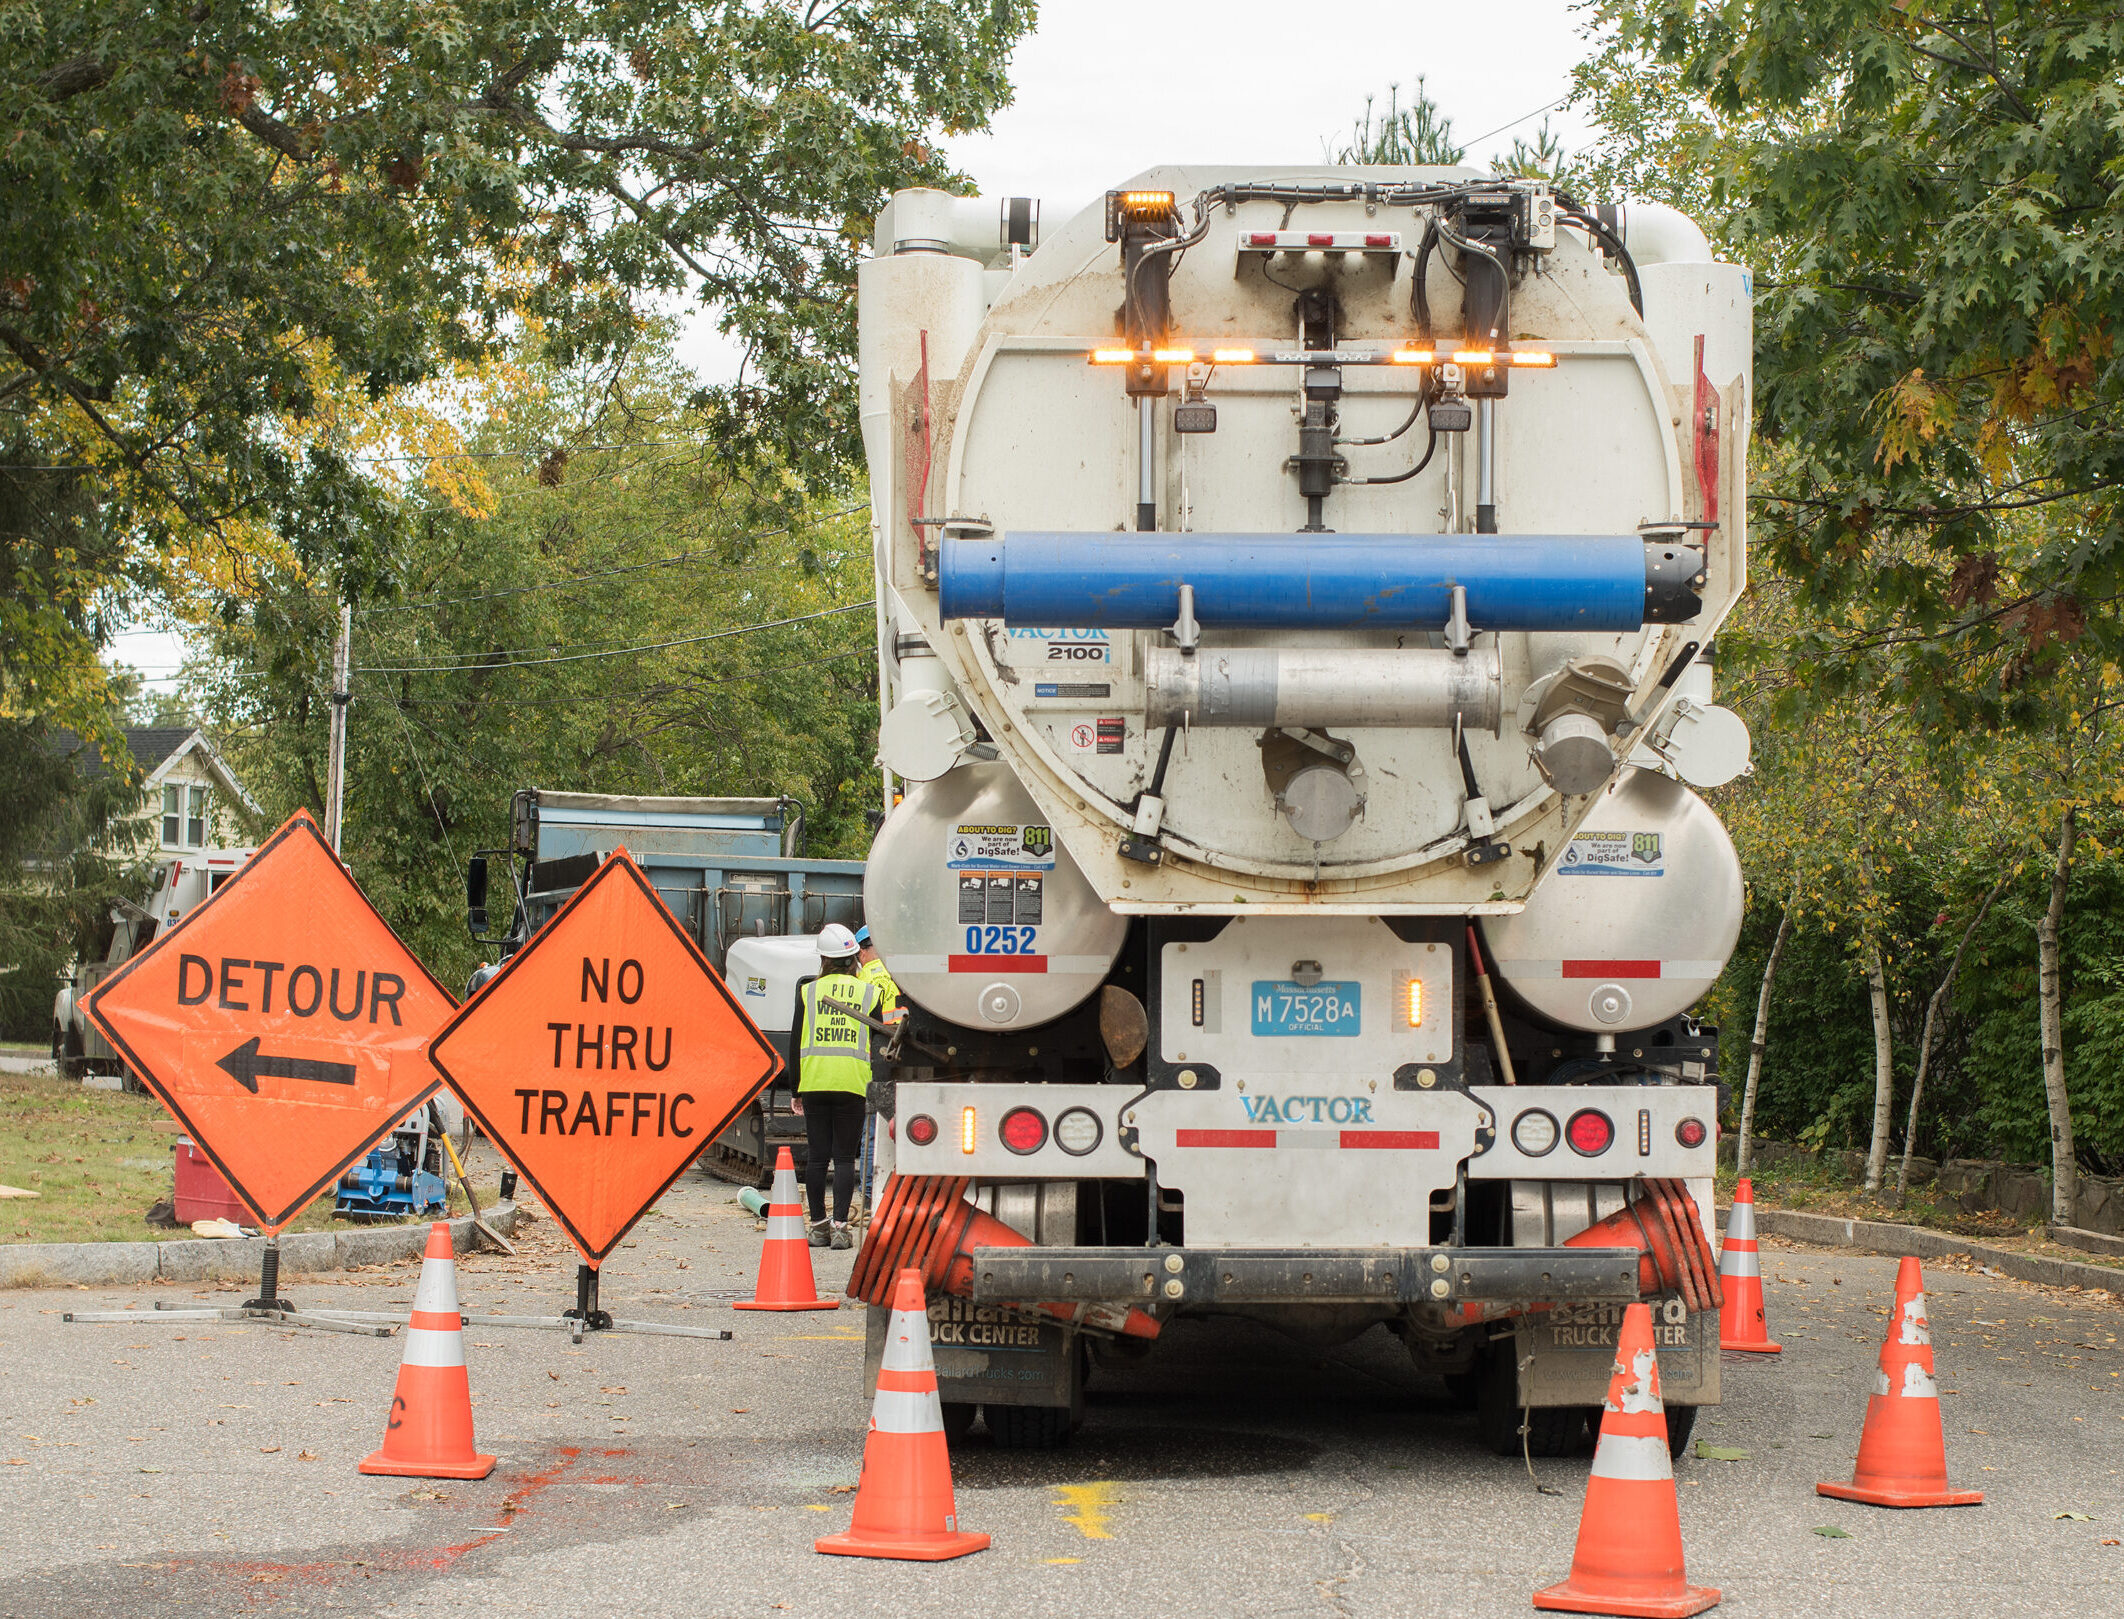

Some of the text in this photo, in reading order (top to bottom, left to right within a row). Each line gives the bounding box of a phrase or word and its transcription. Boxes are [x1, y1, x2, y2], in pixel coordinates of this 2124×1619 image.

[1048, 647, 1111, 664] 2100i
[957, 825, 1018, 835] ABOUT TO DIG?
[1024, 826, 1051, 846] 811
[1573, 832, 1627, 841] BOUT TO DIG?
[977, 847, 1020, 857] DigSafe!
[1633, 834, 1659, 852] 811
[1587, 853, 1629, 863] DigSafe!
[966, 925, 1037, 954] 0252
[178, 954, 406, 1026] DETOUR
[581, 957, 644, 1005] NO
[1257, 995, 1272, 1023] M
[830, 1017, 846, 1026] AND
[1288, 1023, 1324, 1031] OFFICIAL
[816, 1027, 857, 1043] SEWER
[547, 1023, 672, 1072] THRU
[514, 1089, 696, 1138] TRAFFIC
[1239, 1096, 1376, 1123] VACTOR
[929, 1322, 1040, 1345] UCK CENTER
[1551, 1326, 1612, 1345] TRUCK
